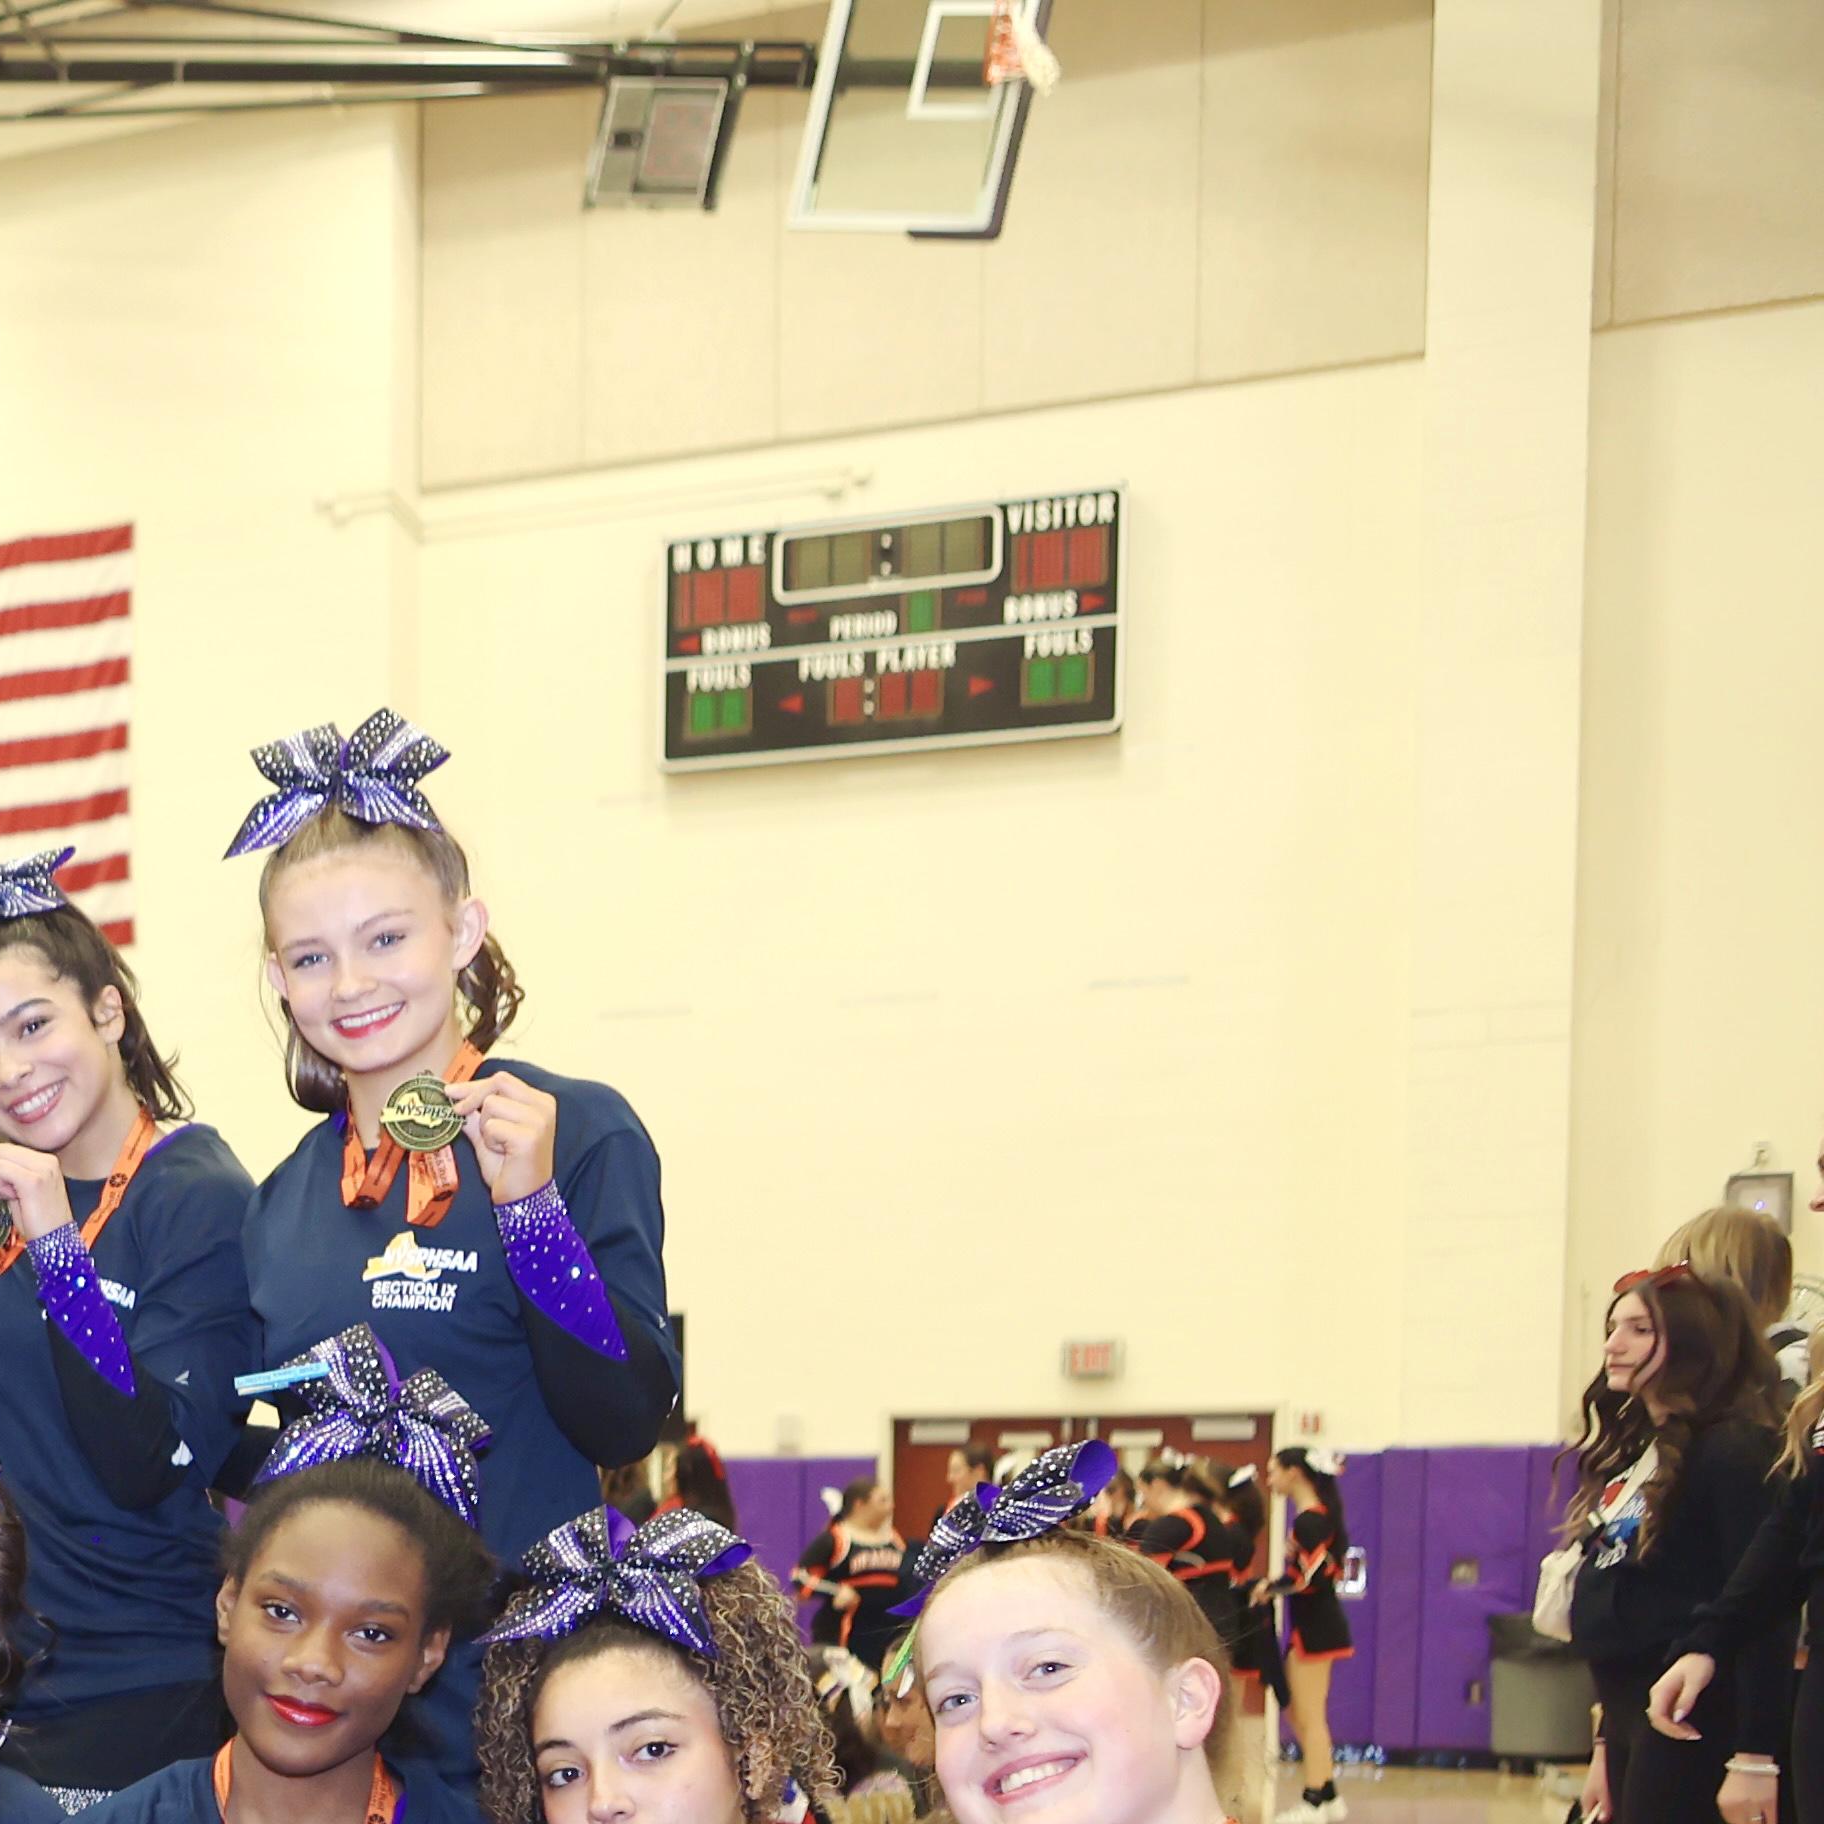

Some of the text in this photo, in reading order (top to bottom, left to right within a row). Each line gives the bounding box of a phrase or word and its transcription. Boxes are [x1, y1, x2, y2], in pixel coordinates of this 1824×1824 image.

[1005, 492, 1116, 535] VISITOR
[672, 535, 766, 573] HOME
[1003, 591, 1079, 625] BONUS
[701, 622, 772, 655] BONUS
[829, 609, 898, 641] PERIOD
[1024, 628, 1094, 659] FOULS
[798, 642, 956, 682] FOULS PLAYER
[687, 663, 751, 694] FOULS
[383, 1247, 478, 1273] NYSPHSAA
[372, 1281, 458, 1298] SECTION IX
[372, 1296, 454, 1312] CHAMPION
